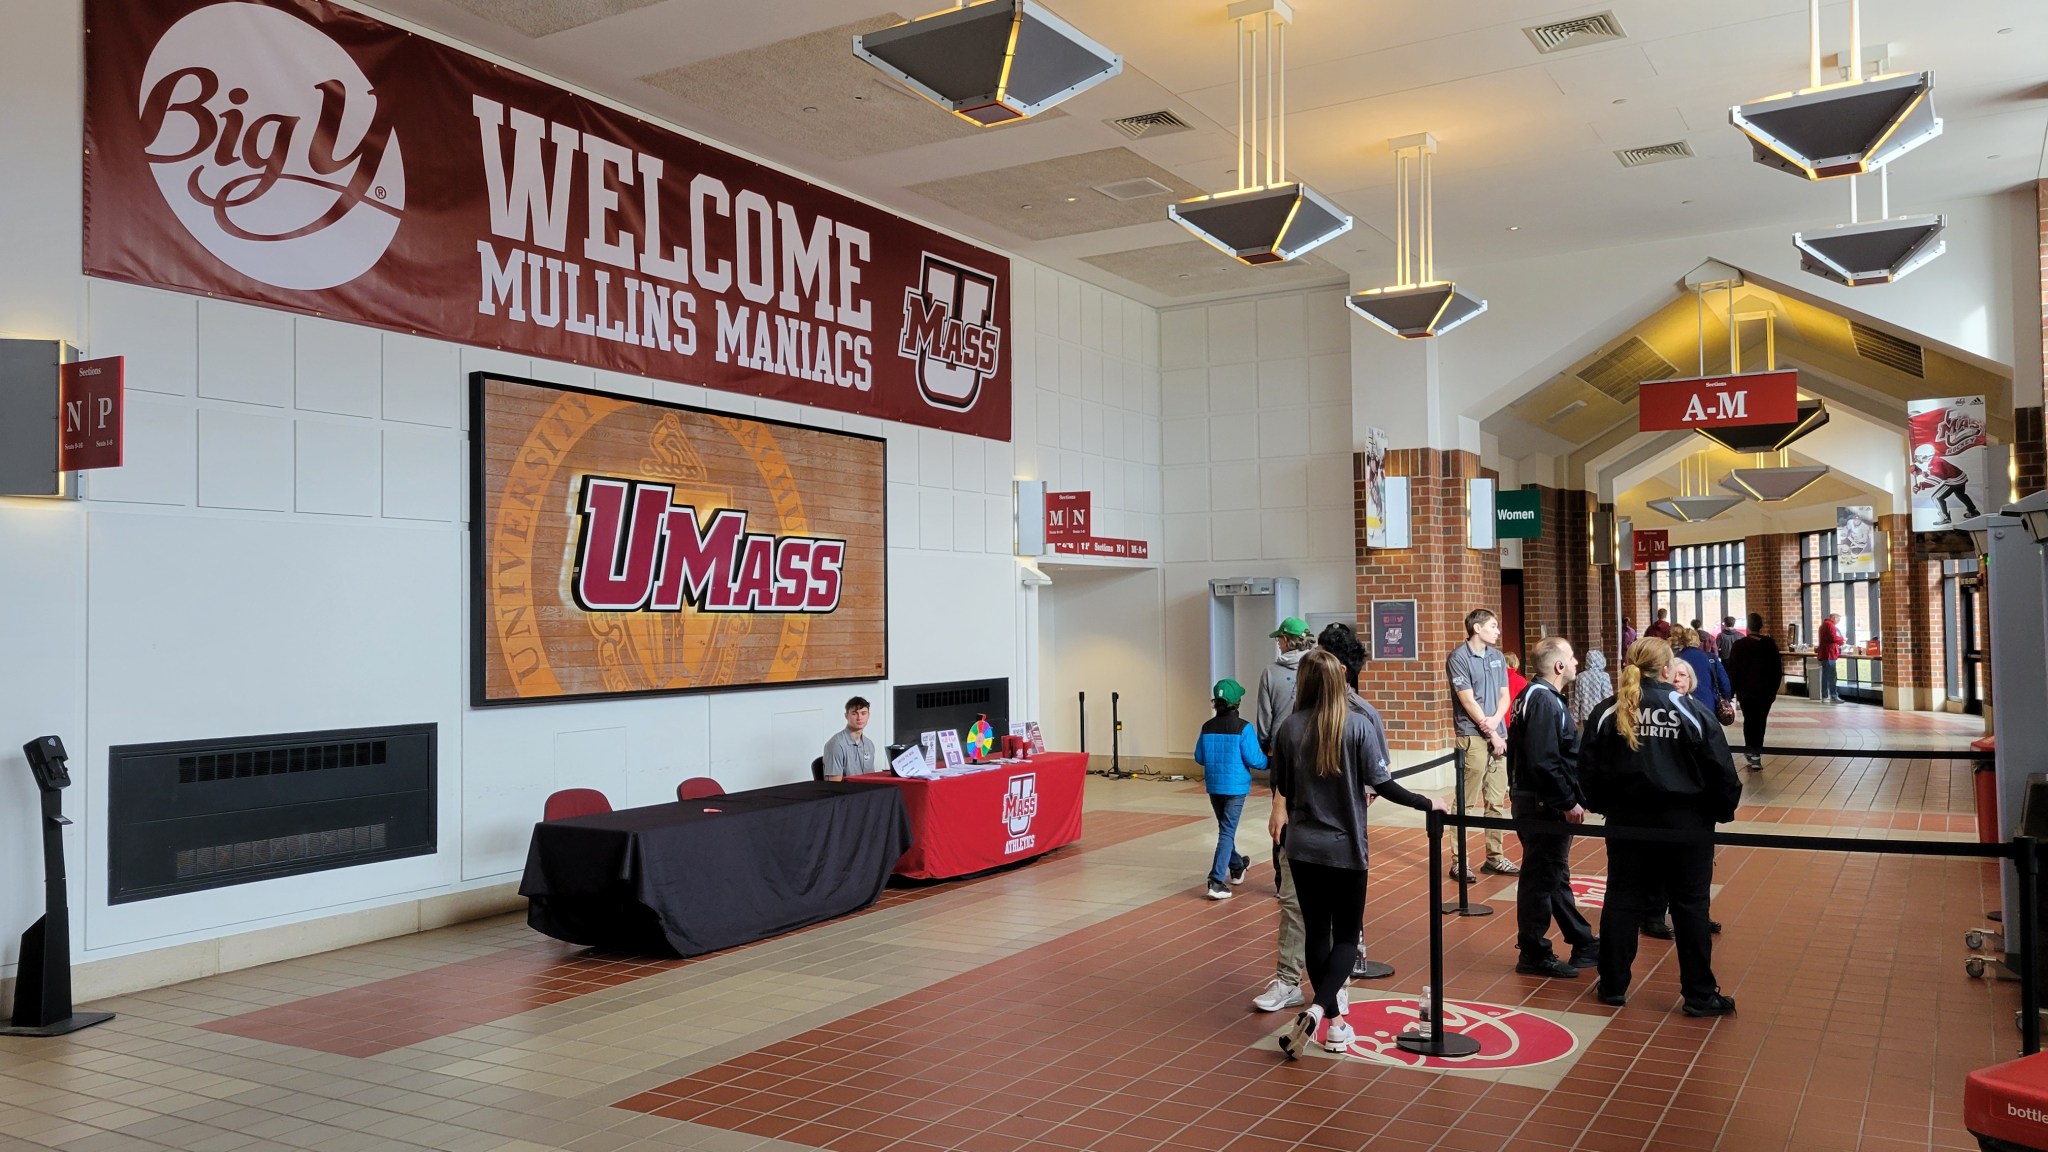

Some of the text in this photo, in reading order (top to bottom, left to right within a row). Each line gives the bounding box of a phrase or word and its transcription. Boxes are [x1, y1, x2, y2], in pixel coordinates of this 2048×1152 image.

[139, 66, 301, 208] Big
[473, 94, 872, 332] WELCOME
[476, 240, 872, 391] MULLINS MANIACS
[79, 367, 102, 377] Sections
[66, 400, 83, 432] N
[97, 397, 113, 429] P
[1682, 390, 1748, 422] A-M
[1049, 510, 1064, 526] M
[1072, 509, 1085, 525] N
[1497, 509, 1535, 520] Women
[1638, 541, 1646, 551] L
[1654, 540, 1665, 551] M
[1633, 725, 1680, 739] CURITY
[1004, 834, 1036, 855] ATHLETICS
[2007, 1102, 2048, 1124] bottle
